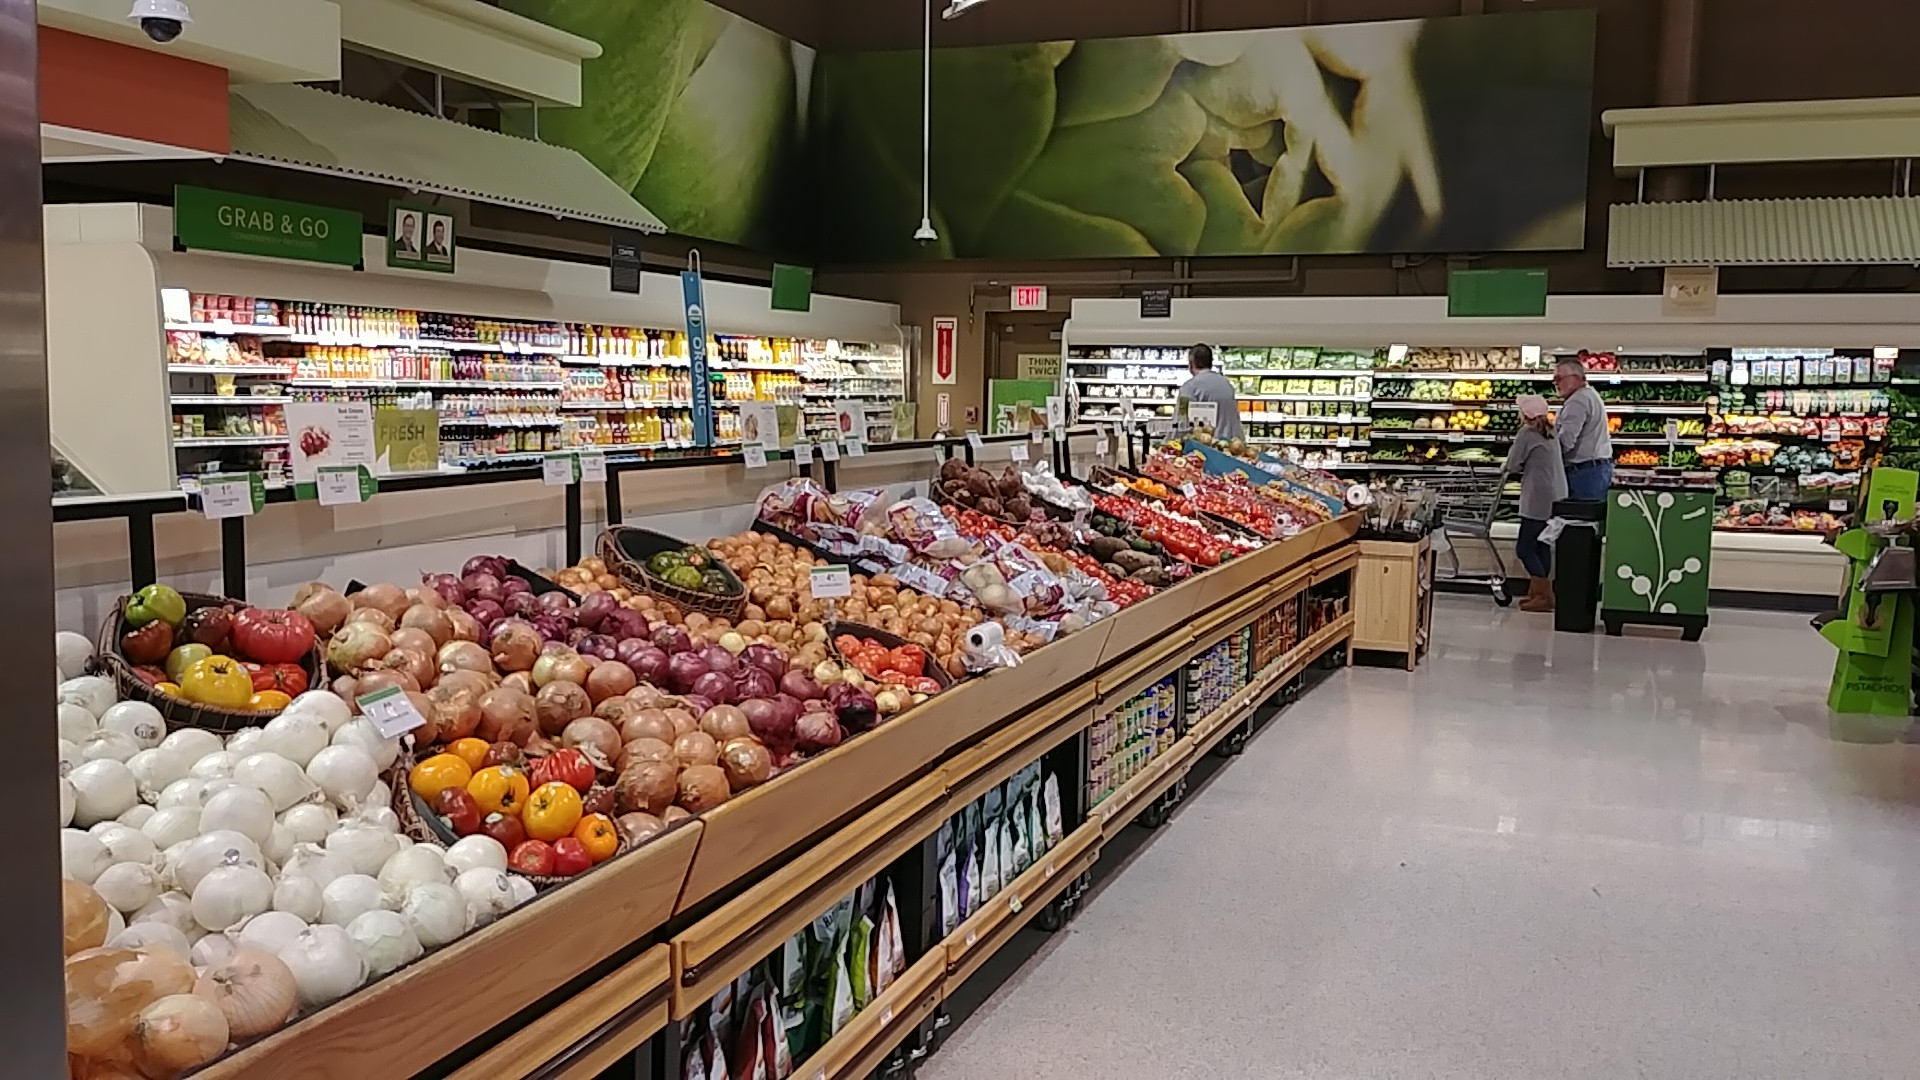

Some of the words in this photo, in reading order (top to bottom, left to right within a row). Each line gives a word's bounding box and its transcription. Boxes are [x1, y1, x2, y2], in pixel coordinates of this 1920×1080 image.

[217, 205, 275, 232] GRAB
[280, 214, 293, 234] &
[299, 217, 329, 239] GO
[1018, 288, 1041, 306] EXIT
[1028, 357, 1058, 366] THINK
[692, 336, 708, 417] ORGANIC
[1028, 366, 1058, 376] TWICE
[380, 425, 425, 441] FRESH
